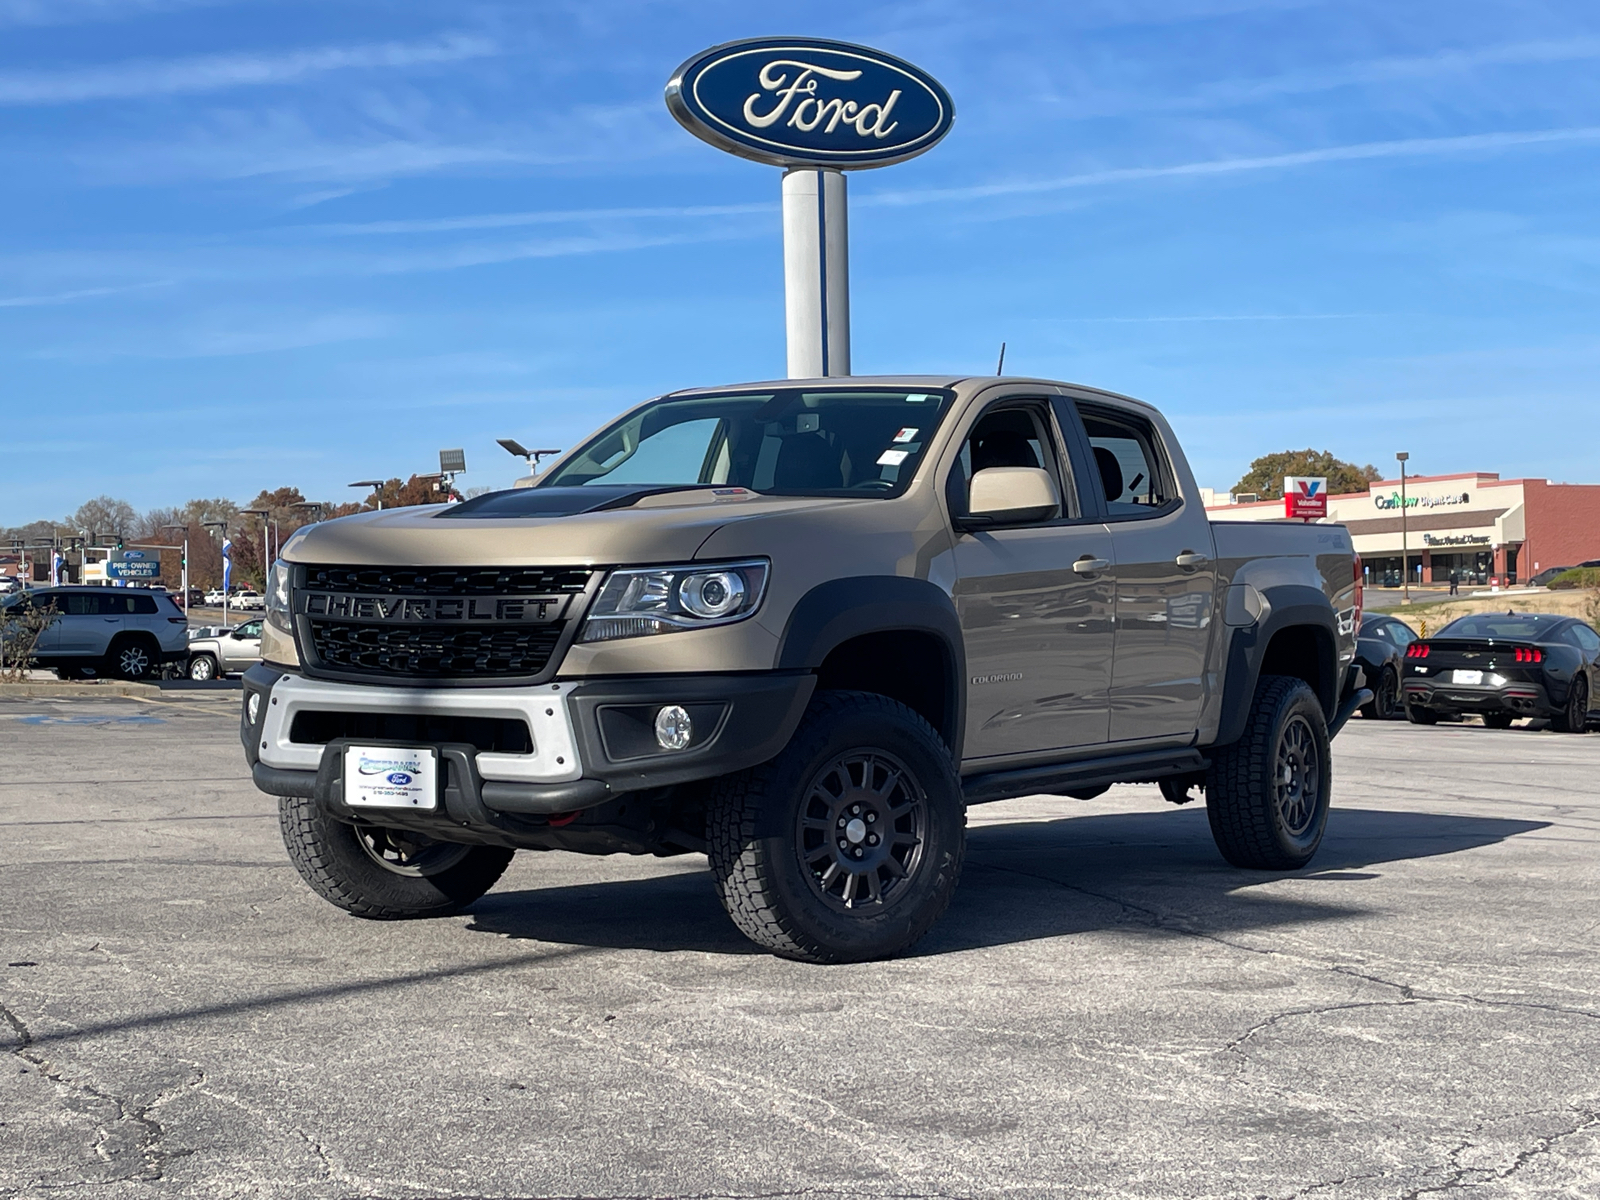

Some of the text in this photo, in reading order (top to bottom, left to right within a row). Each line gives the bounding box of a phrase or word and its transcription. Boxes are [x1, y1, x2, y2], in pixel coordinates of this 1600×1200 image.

[743, 60, 902, 139] Ford
[304, 594, 558, 620] CHEVROLET
[971, 672, 1023, 685] COLORADO
[391, 774, 408, 784] Ford
